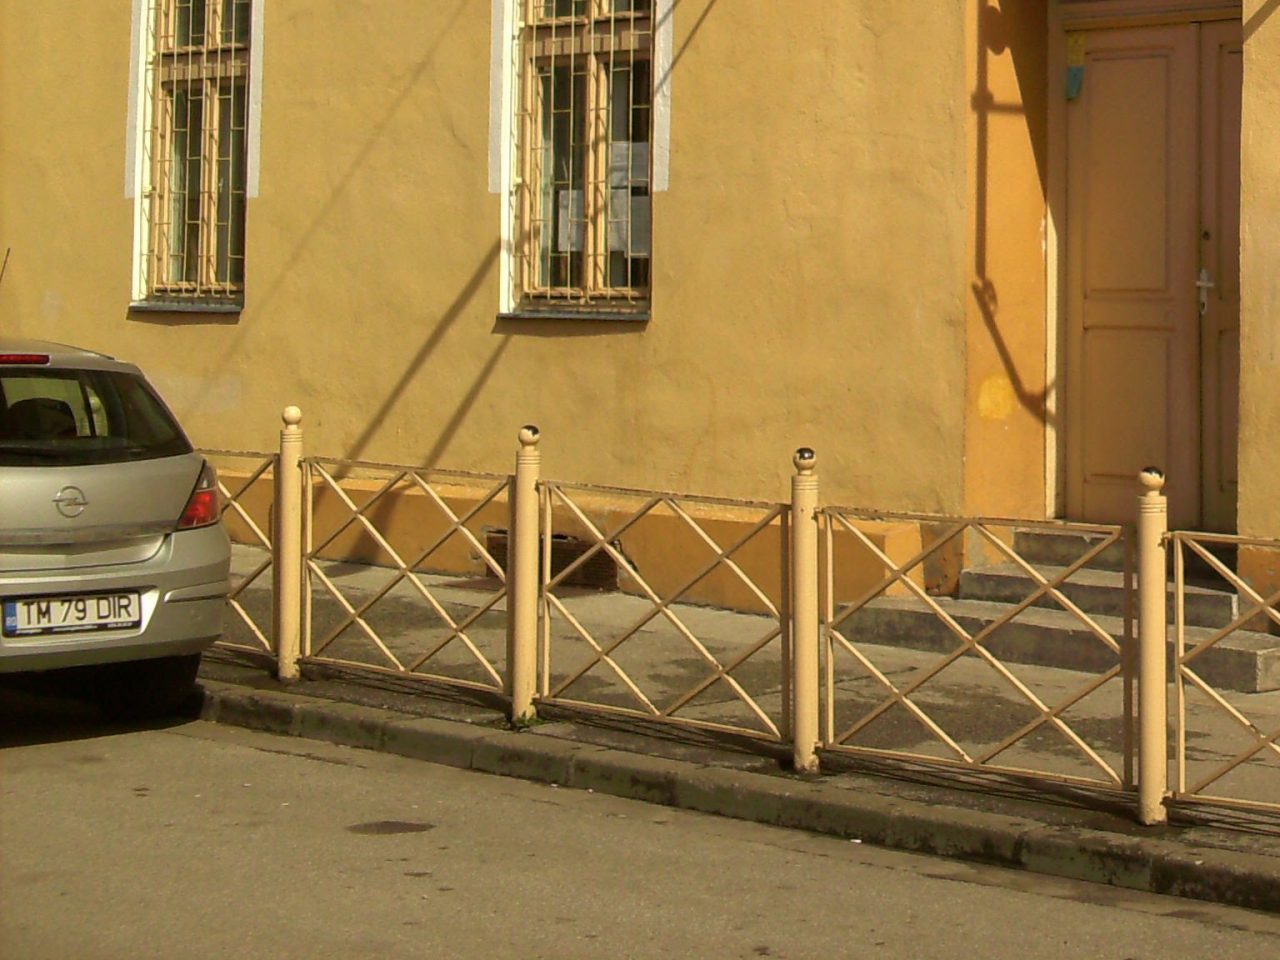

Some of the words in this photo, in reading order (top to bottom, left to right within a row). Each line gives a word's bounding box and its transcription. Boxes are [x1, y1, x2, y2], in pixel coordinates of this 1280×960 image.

[22, 600, 52, 626] TM
[60, 598, 87, 623] 79
[96, 595, 133, 620] DIR
